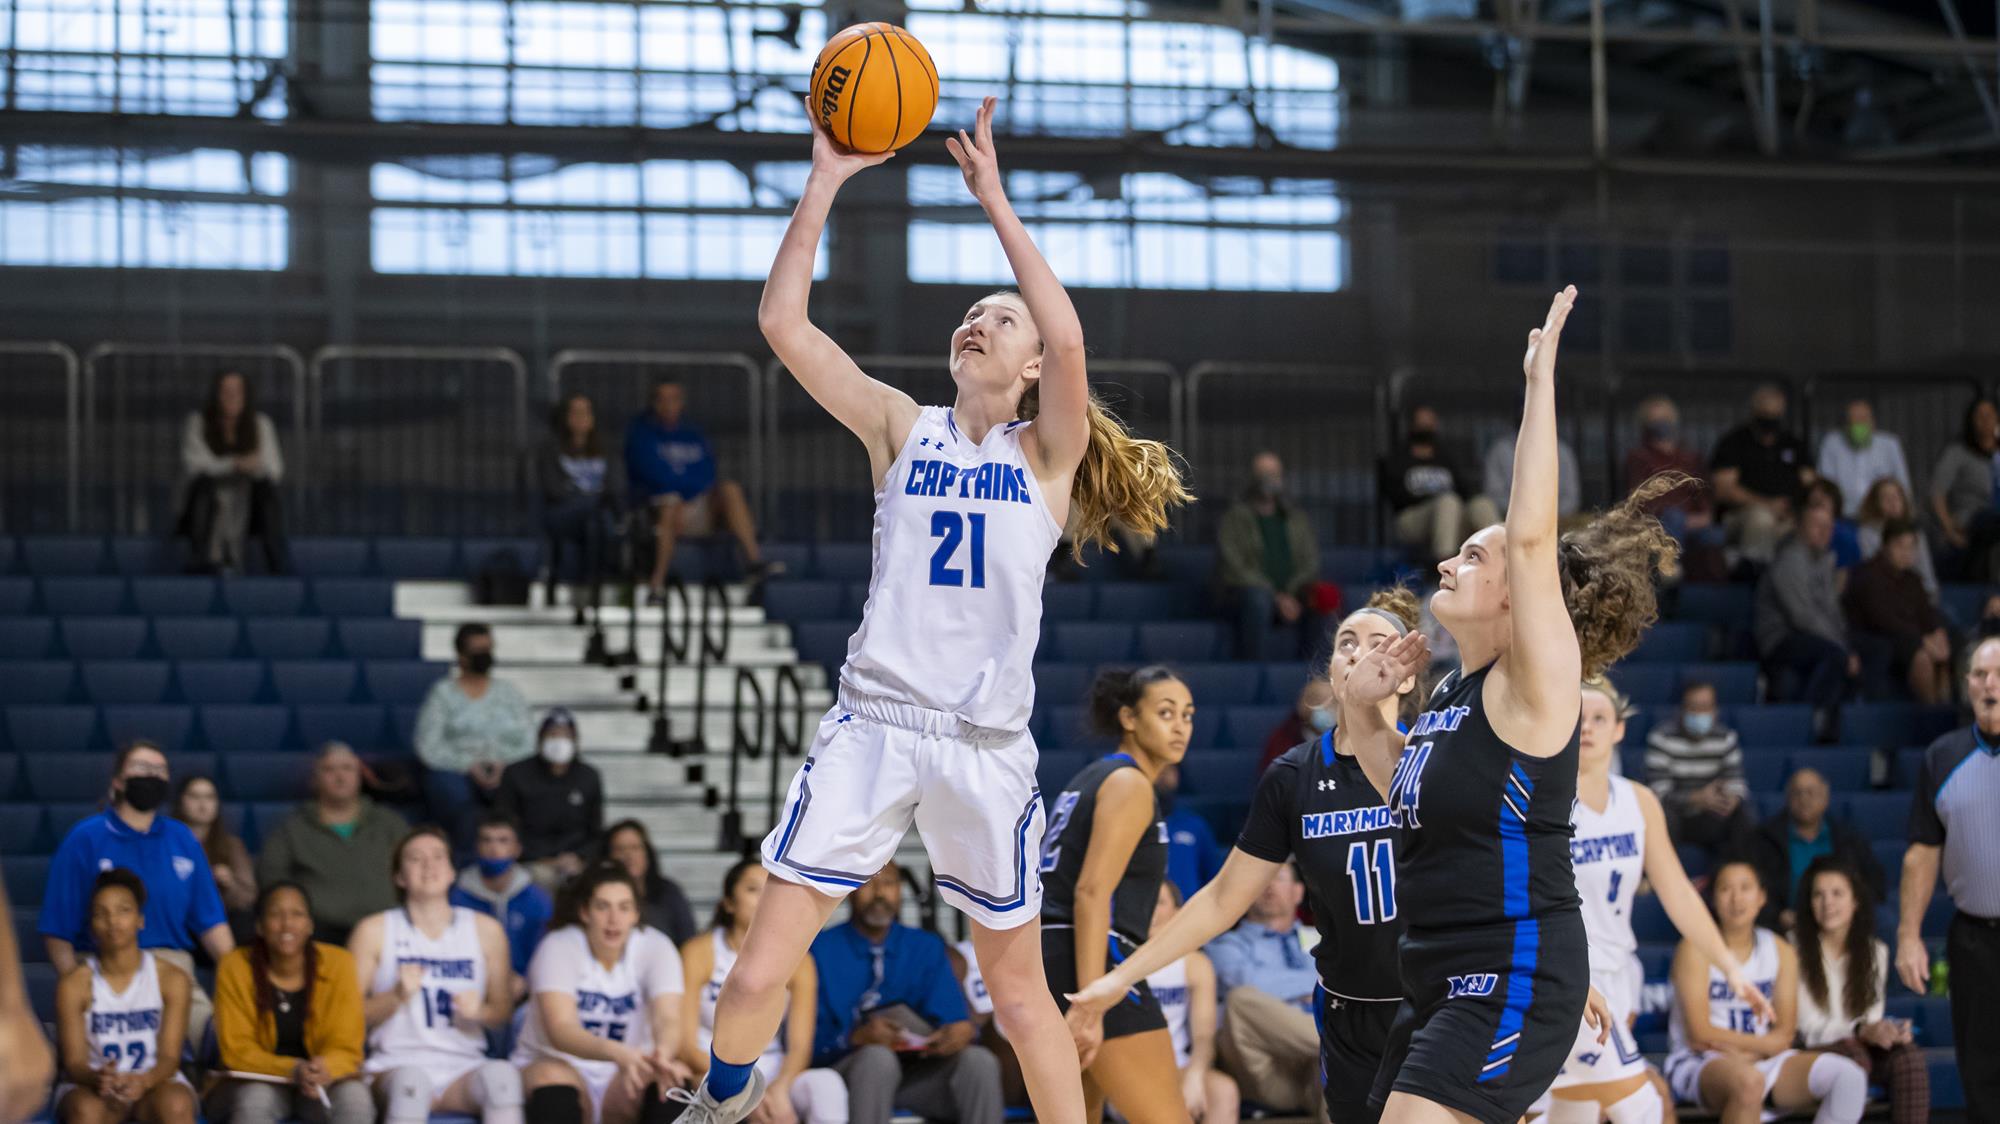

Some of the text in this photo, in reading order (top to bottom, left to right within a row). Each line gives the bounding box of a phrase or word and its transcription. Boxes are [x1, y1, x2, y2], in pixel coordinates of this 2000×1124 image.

[905, 460, 1032, 504] CAPTAINS
[929, 510, 986, 589] 21
[1302, 804, 1395, 839] MARYMO
[1346, 838, 1397, 924] 11
[1446, 973, 1499, 999] MU
